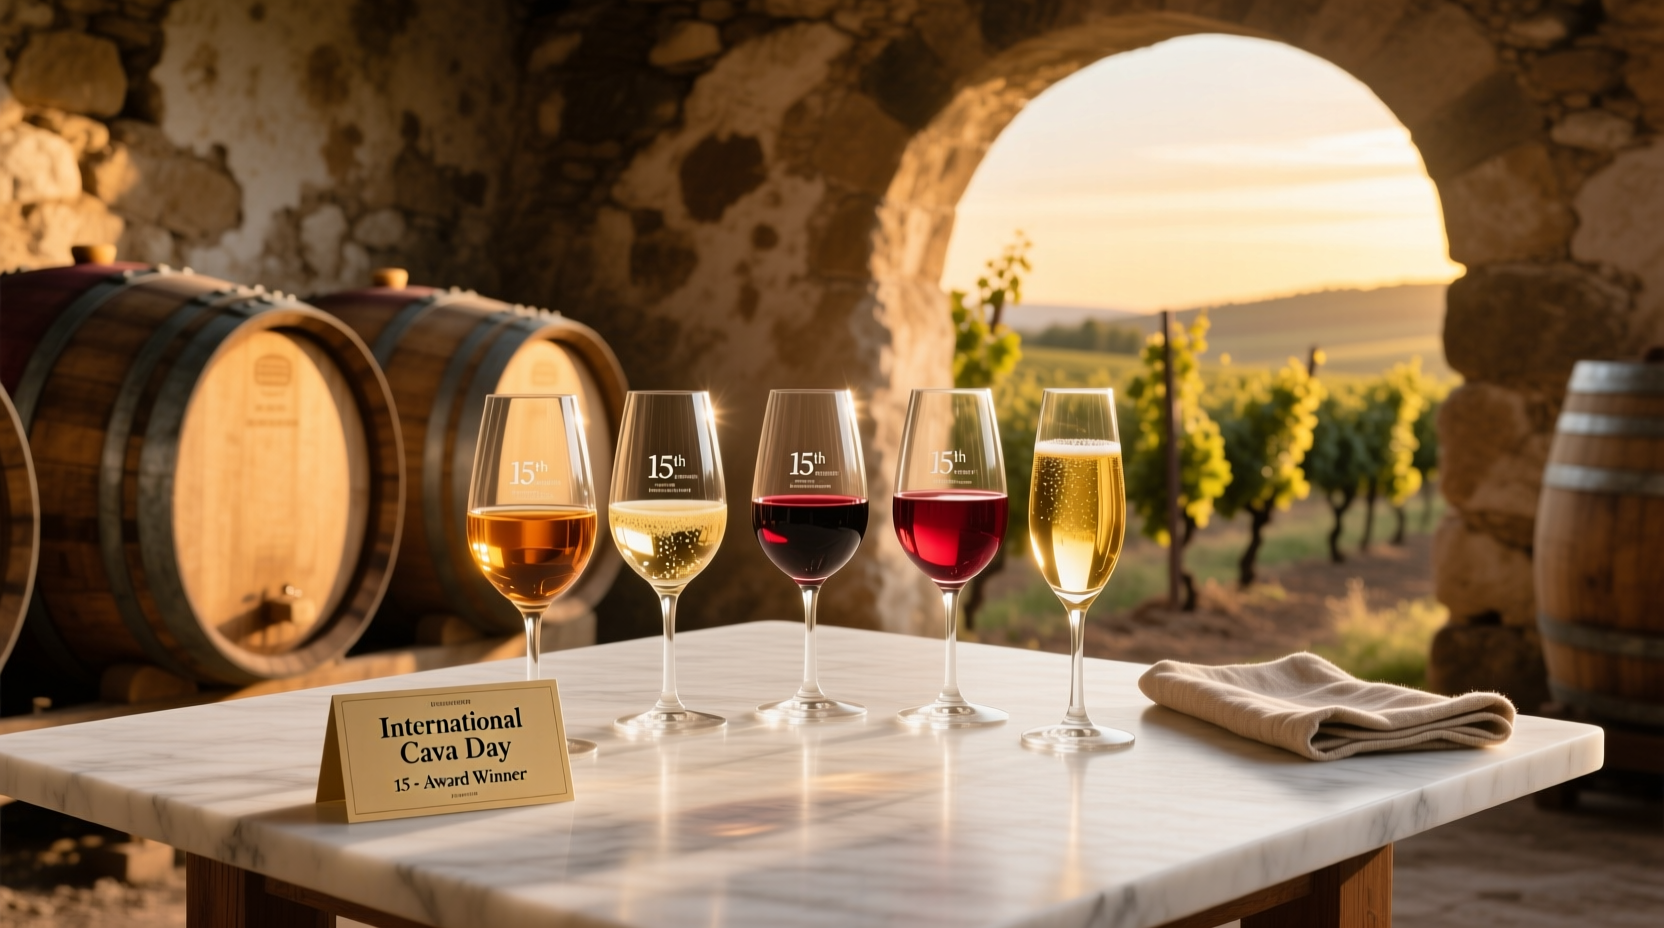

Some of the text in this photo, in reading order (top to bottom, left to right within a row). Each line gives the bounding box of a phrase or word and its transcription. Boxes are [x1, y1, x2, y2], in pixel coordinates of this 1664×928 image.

[509, 460, 548, 485] 15th
[648, 454, 686, 479] 15th
[789, 451, 826, 476] 15th
[930, 450, 966, 475] 15th
[379, 707, 523, 739] International
[400, 737, 512, 764] Cava Day
[394, 777, 411, 793] 15
[423, 770, 470, 790] Award
[473, 769, 528, 785] Winner
